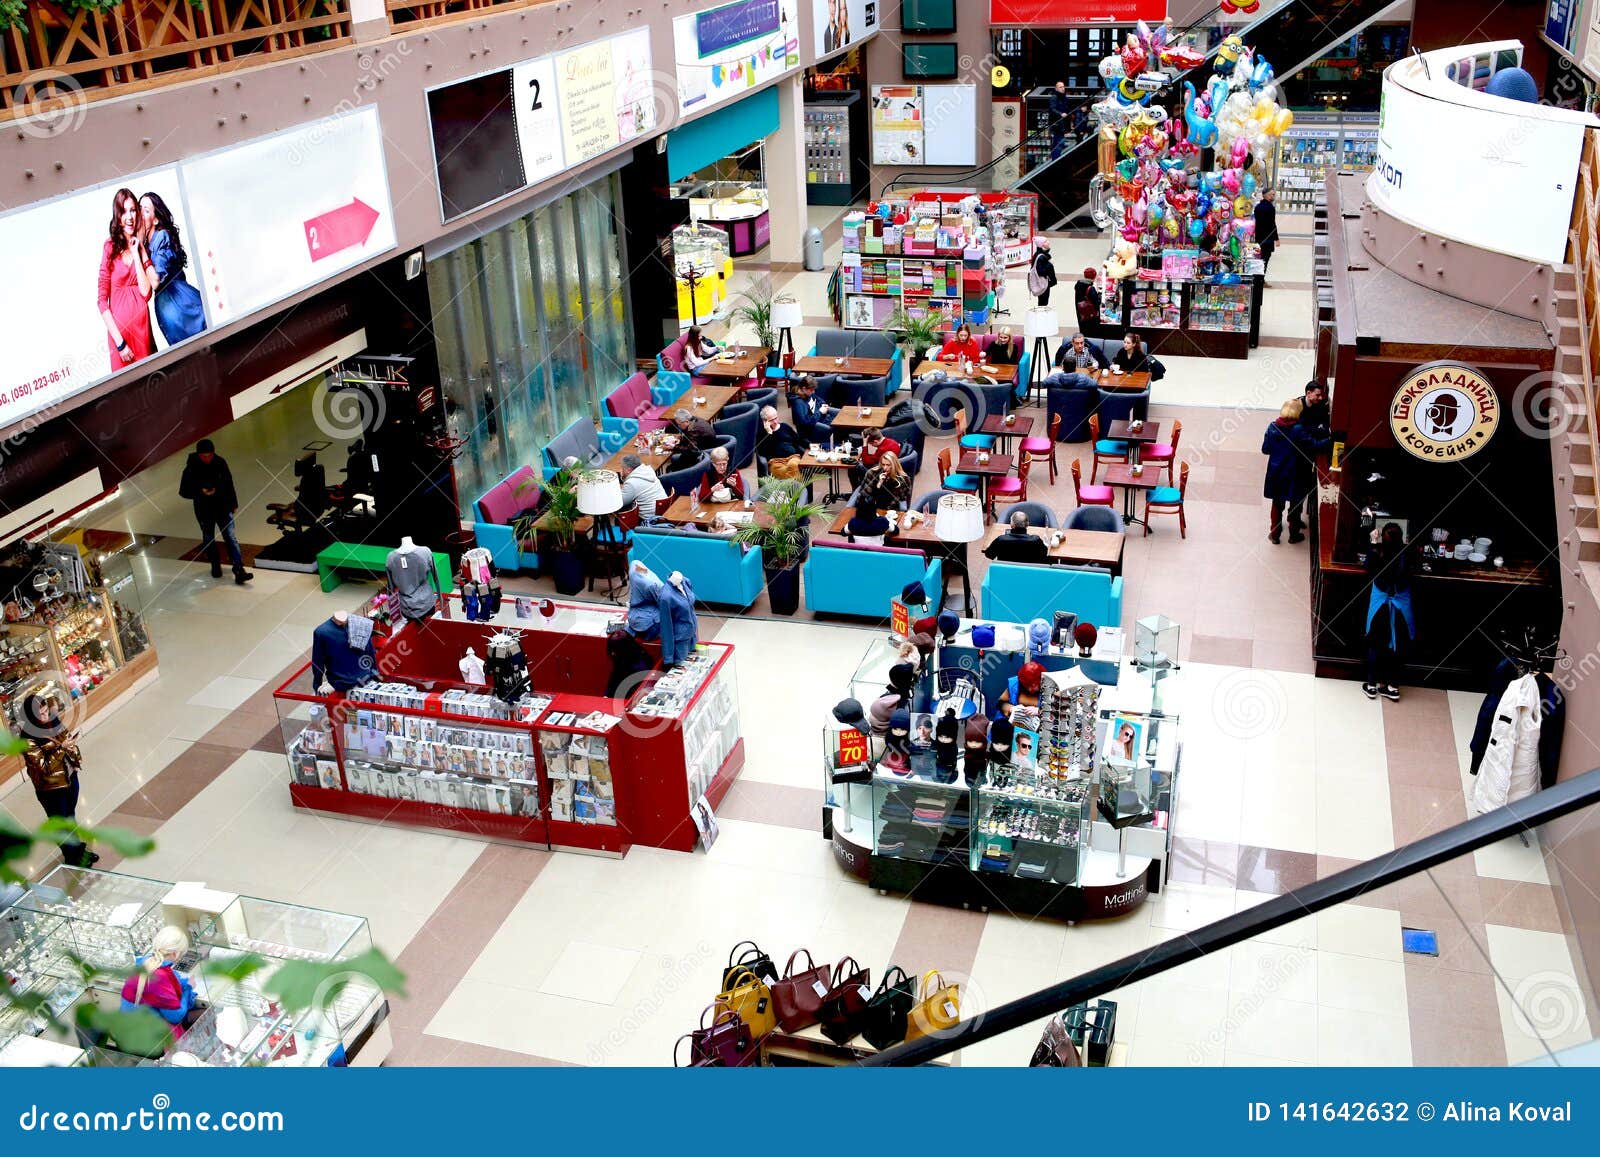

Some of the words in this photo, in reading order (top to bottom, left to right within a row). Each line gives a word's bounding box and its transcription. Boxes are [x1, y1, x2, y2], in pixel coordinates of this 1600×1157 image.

[528, 79, 543, 112] 2
[309, 226, 320, 250] 2
[11, 382, 33, 402] (050)
[33, 366, 71, 391] 223-06-11
[1393, 372, 1495, 424] ШОКОЛАДНИЦА
[1405, 433, 1477, 458] КОФЕЙНЯ
